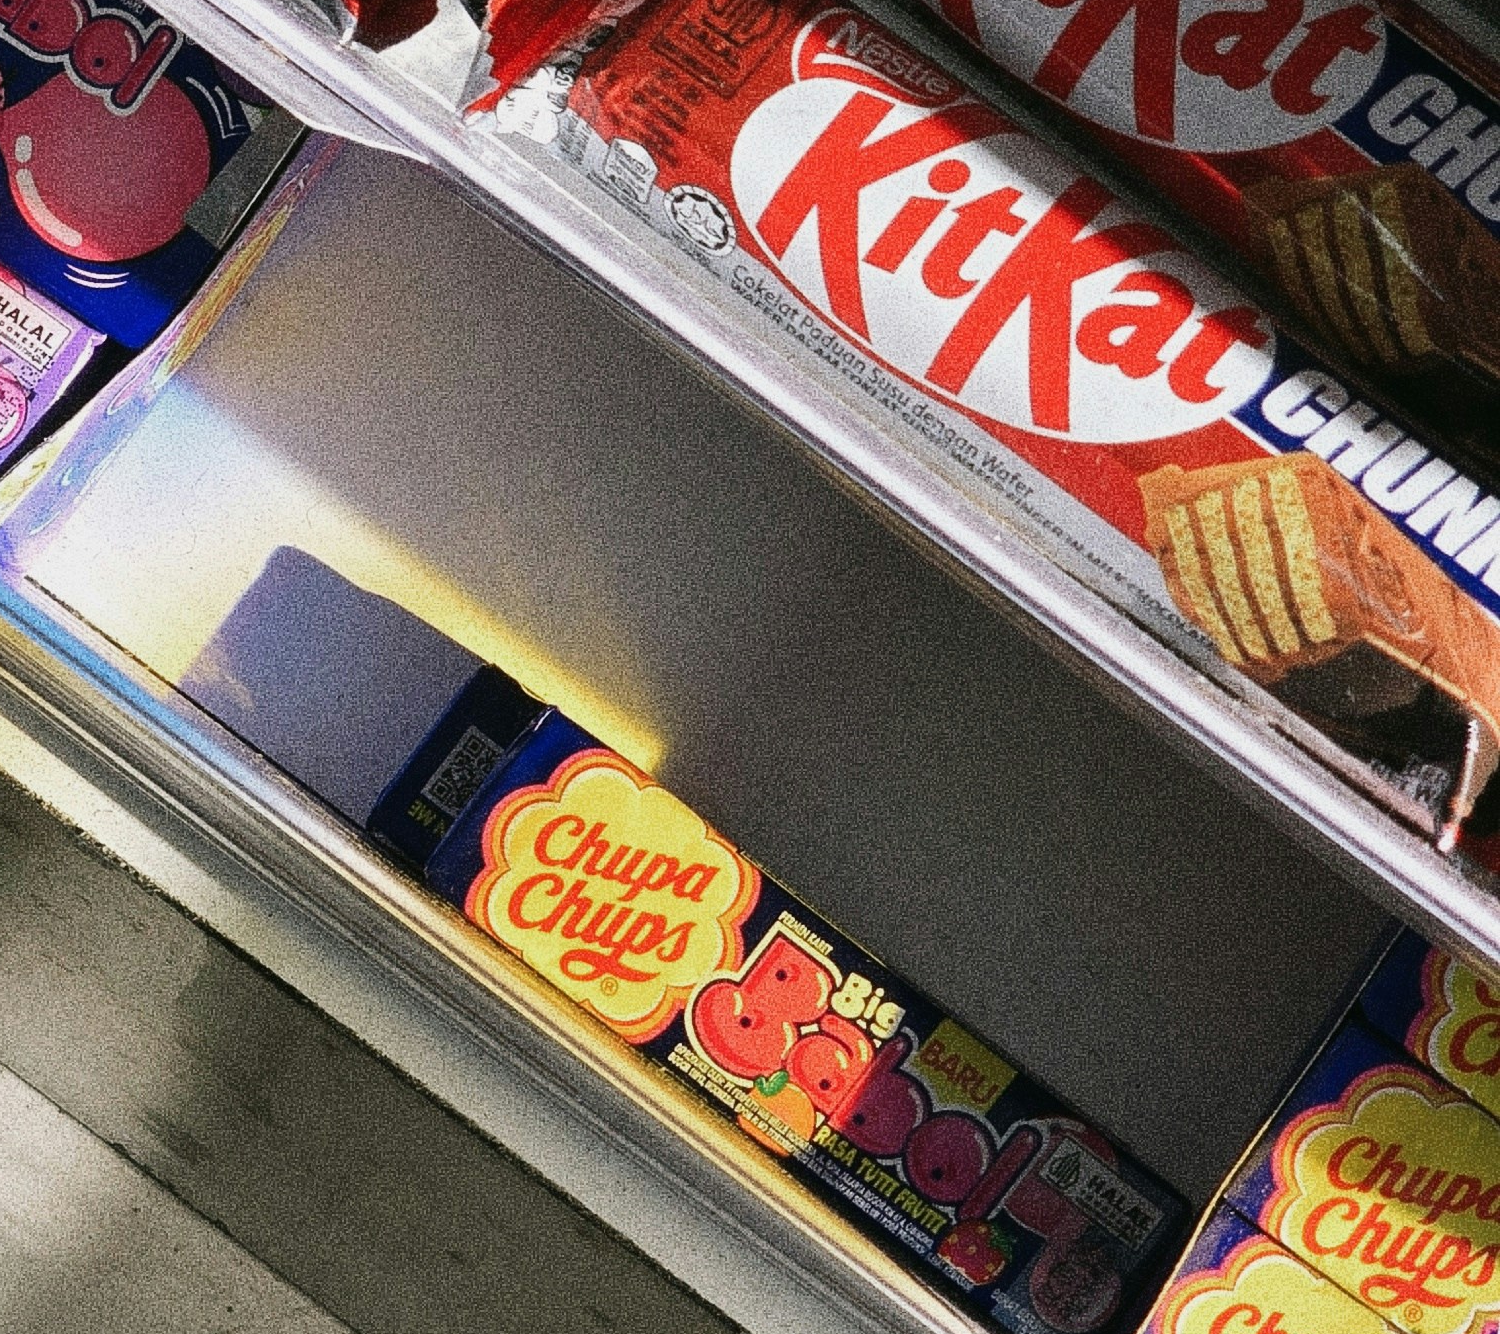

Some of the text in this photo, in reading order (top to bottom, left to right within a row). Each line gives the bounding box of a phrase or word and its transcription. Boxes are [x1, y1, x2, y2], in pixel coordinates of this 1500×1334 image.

[728, 262, 1037, 500] Cokelat Paduan Susu dengan Wafer
[754, 91, 1500, 581] KitKat CHUN
[535, 815, 719, 903] Chupa
[508, 876, 694, 982] Chups
[775, 909, 812, 940] PERMEN
[831, 972, 903, 1040] Big
[694, 936, 1041, 1221] Babol
[915, 1037, 1004, 1111] BARU
[811, 1123, 950, 1236] RASA TUTTI FRUTTI
[1302, 1197, 1500, 1309] Chups
